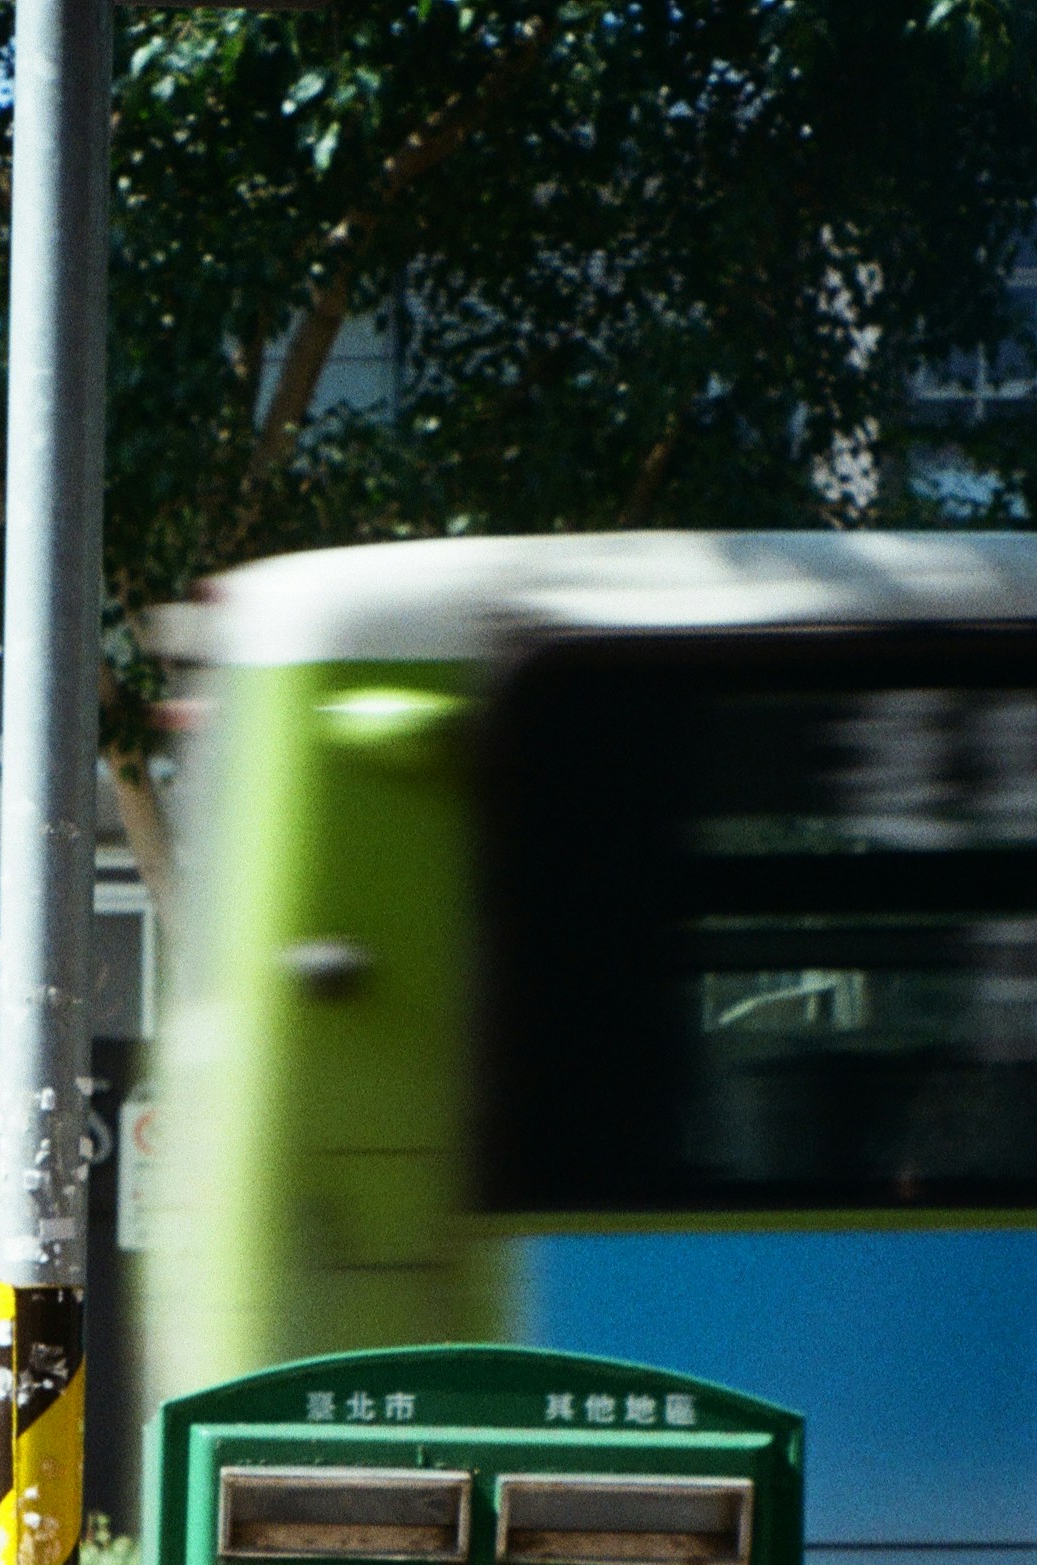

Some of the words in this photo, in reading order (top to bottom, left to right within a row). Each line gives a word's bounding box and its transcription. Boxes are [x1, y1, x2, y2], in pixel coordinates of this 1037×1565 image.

[307, 1391, 416, 1421] 臺北市
[545, 1393, 696, 1426] 其他地區
